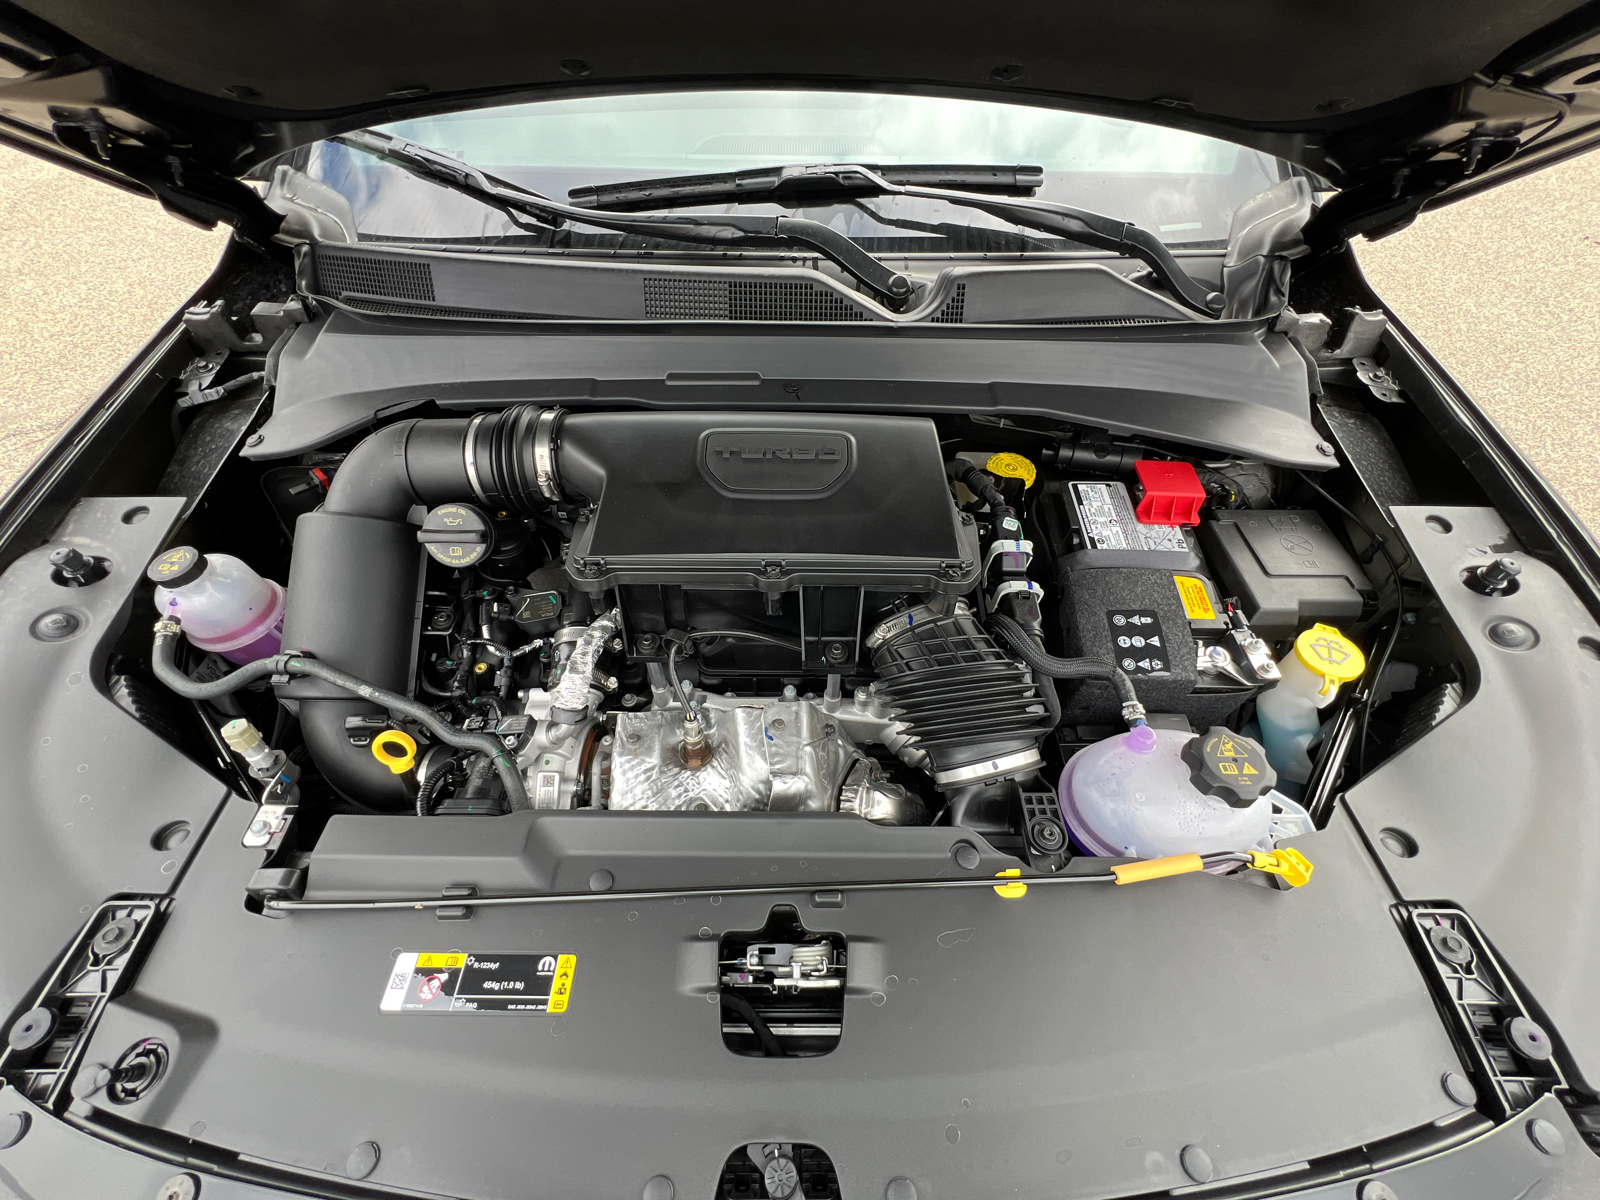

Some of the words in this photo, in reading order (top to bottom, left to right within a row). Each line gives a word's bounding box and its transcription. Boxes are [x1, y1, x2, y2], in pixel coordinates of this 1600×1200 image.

[714, 446, 842, 460] TURBO
[437, 507, 457, 516] ENGINE
[458, 508, 467, 516] OIL
[1175, 538, 1187, 549] Pb
[473, 961, 500, 970] R-1234yf
[482, 980, 500, 991] 454g
[500, 980, 514, 991] (1.0
[514, 980, 525, 991] lb)
